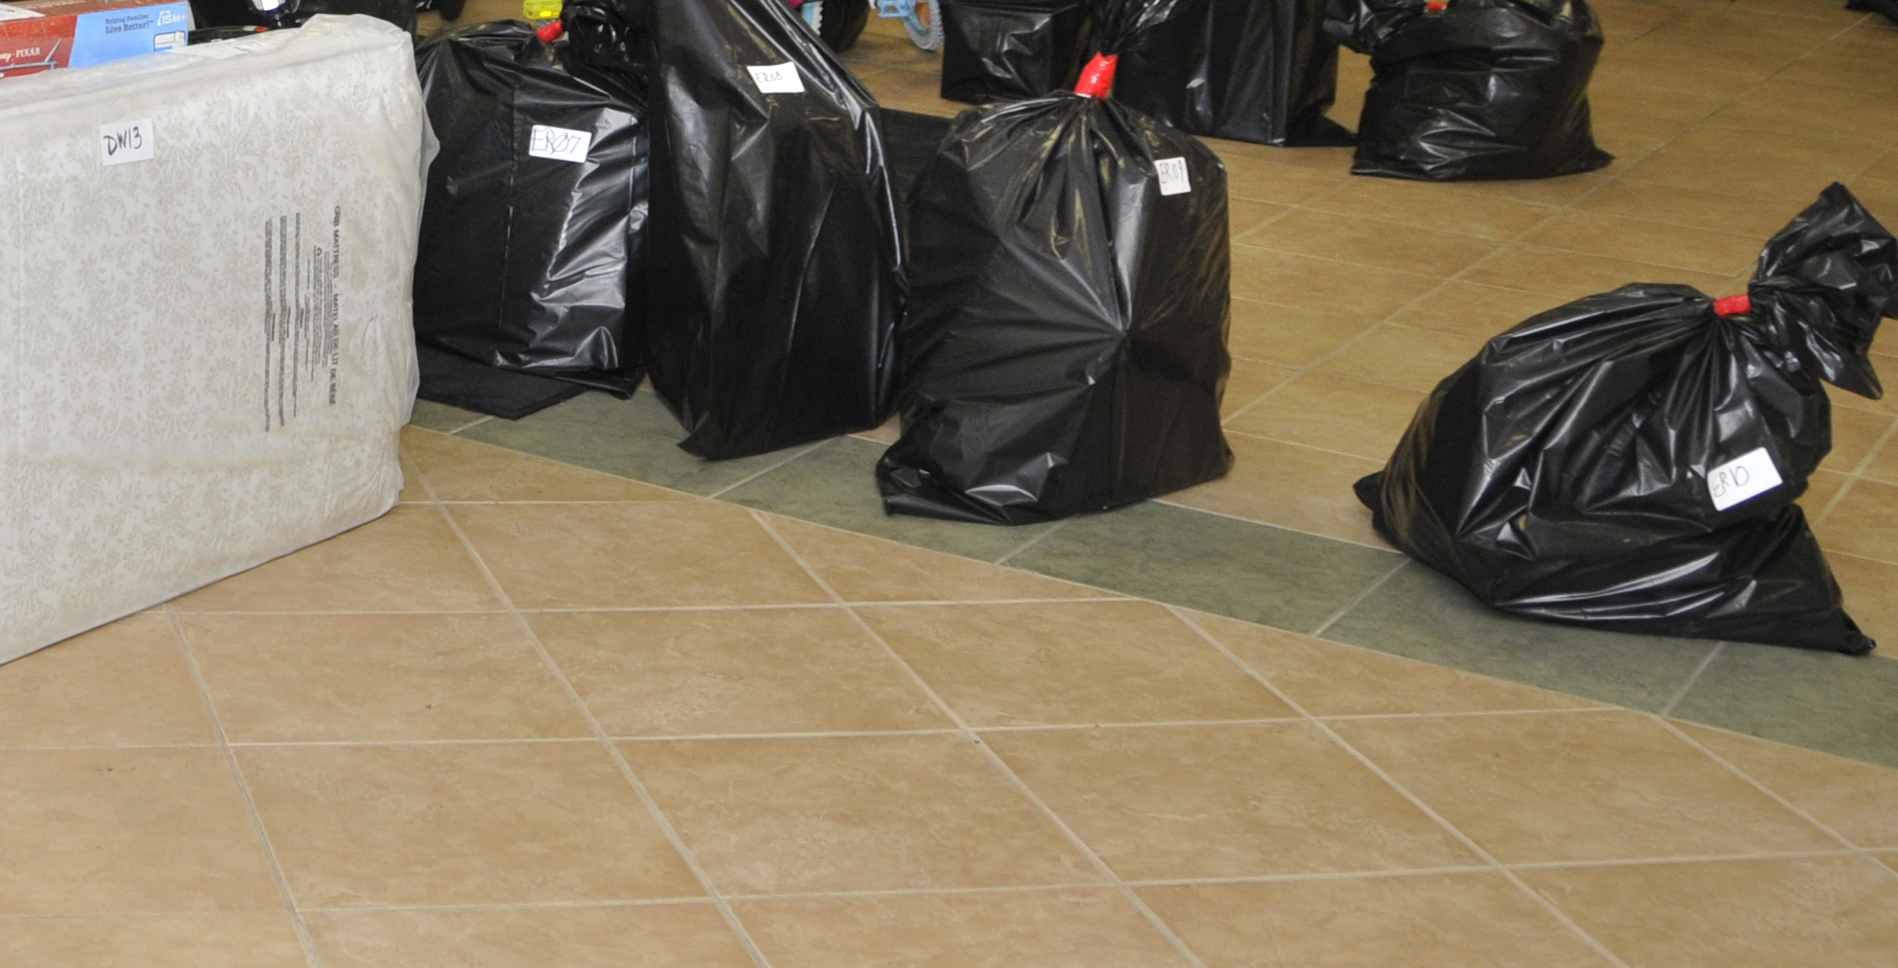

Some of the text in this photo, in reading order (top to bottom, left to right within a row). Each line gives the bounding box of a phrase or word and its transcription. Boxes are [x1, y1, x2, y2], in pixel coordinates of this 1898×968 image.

[105, 15, 126, 24] Helping
[105, 25, 122, 34] Live
[15, 47, 41, 58] PIXAR
[755, 70, 783, 84] ER08
[331, 229, 340, 280] MATTRESS
